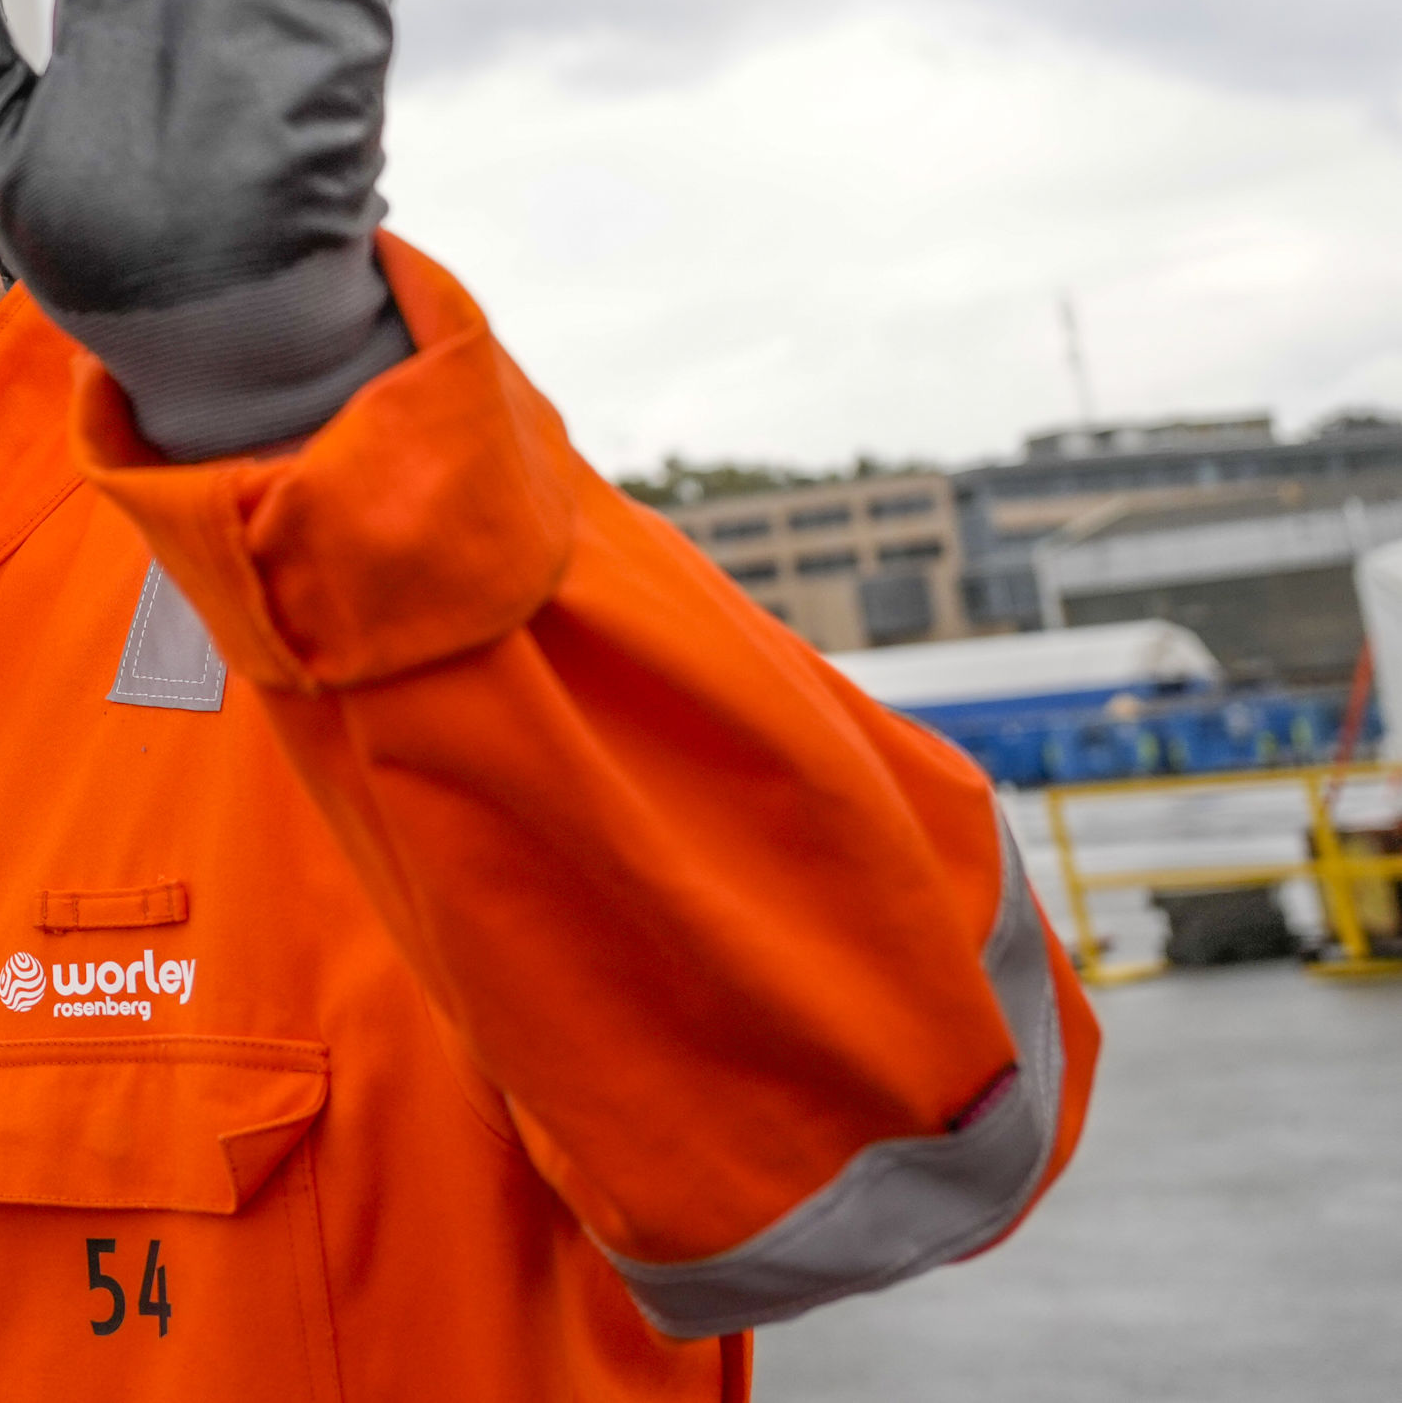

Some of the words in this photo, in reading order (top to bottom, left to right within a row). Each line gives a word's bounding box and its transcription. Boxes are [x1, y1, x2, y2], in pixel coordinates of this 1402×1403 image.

[52, 949, 196, 1005] worley
[53, 996, 152, 1021] rosenberg
[86, 1238, 172, 1337] 54
